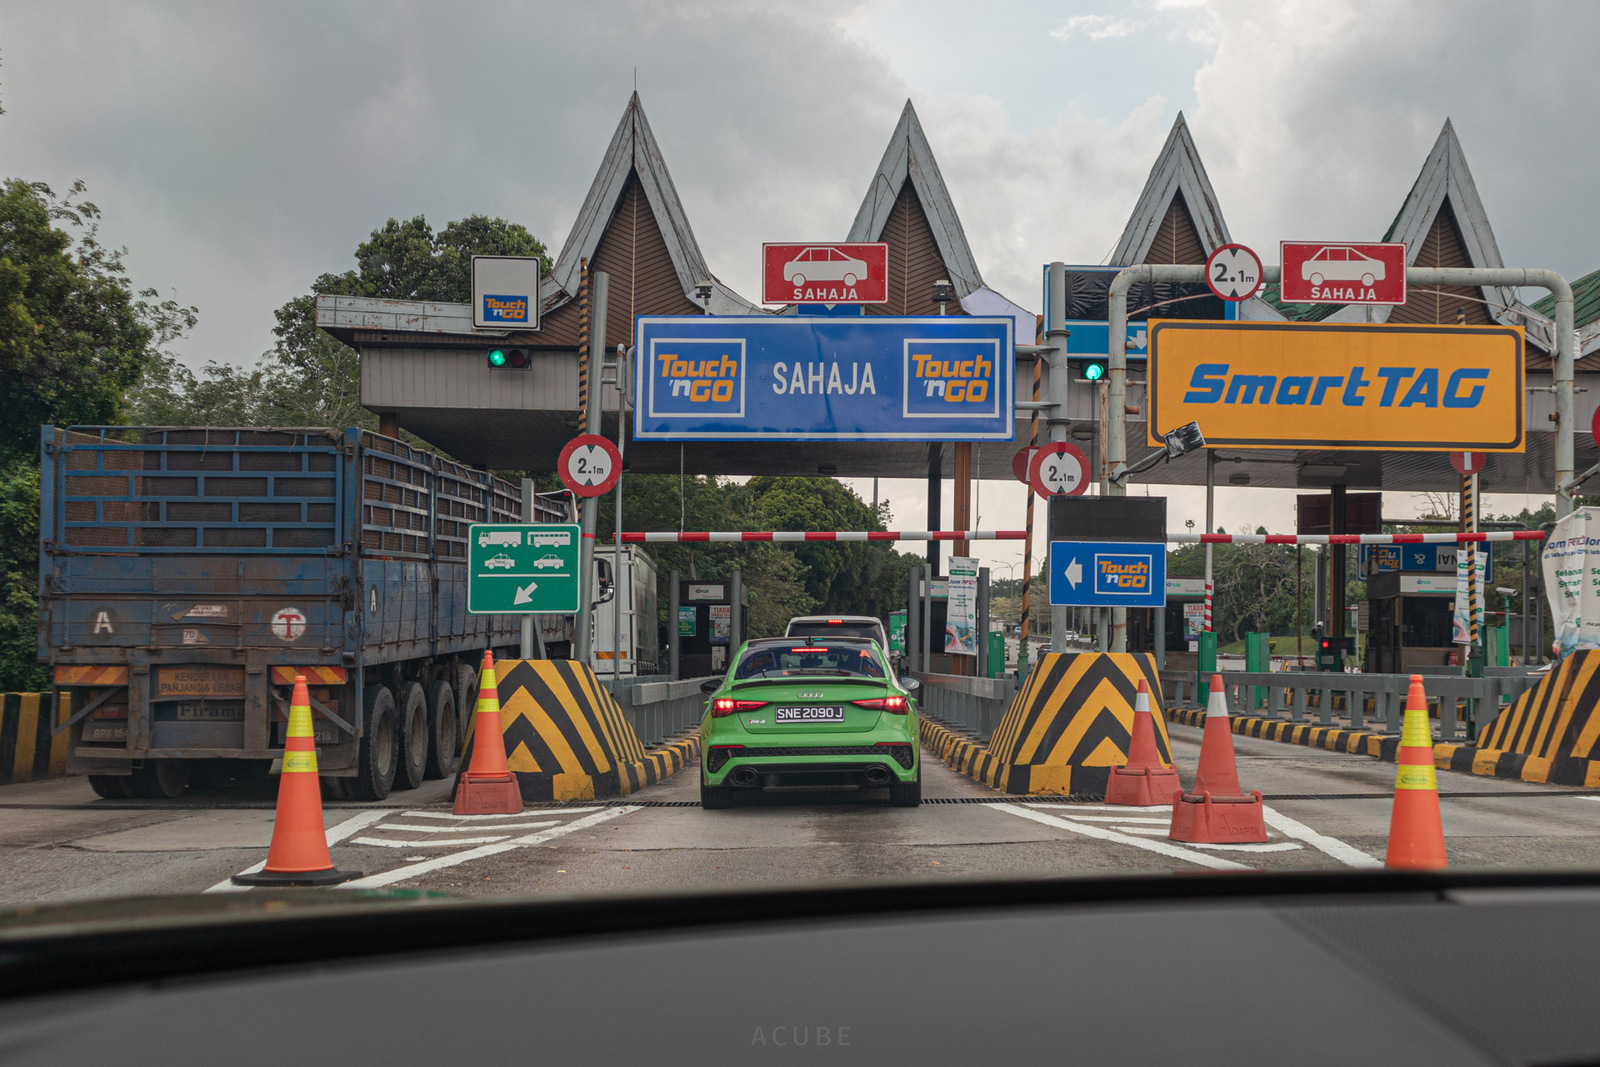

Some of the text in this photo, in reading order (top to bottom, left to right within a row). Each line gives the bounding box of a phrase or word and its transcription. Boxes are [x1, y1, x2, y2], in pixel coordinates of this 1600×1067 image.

[793, 288, 858, 300] SAHAJA
[1311, 287, 1377, 300] SAHAJA
[485, 298, 526, 310] Touch
[657, 354, 737, 378] Touch
[912, 354, 992, 378] Touch
[772, 361, 877, 395] SAHAJA
[1183, 363, 1490, 409] SmartTAG
[577, 457, 604, 475] 2.1m
[1048, 465, 1075, 482] 2.1m
[1099, 561, 1148, 574] Touch
[370, 589, 377, 612] A
[94, 611, 113, 635] A
[278, 614, 301, 639] T
[184, 630, 195, 639] 70
[161, 682, 201, 693] PANJANG
[777, 707, 843, 719] SNE 2090 J
